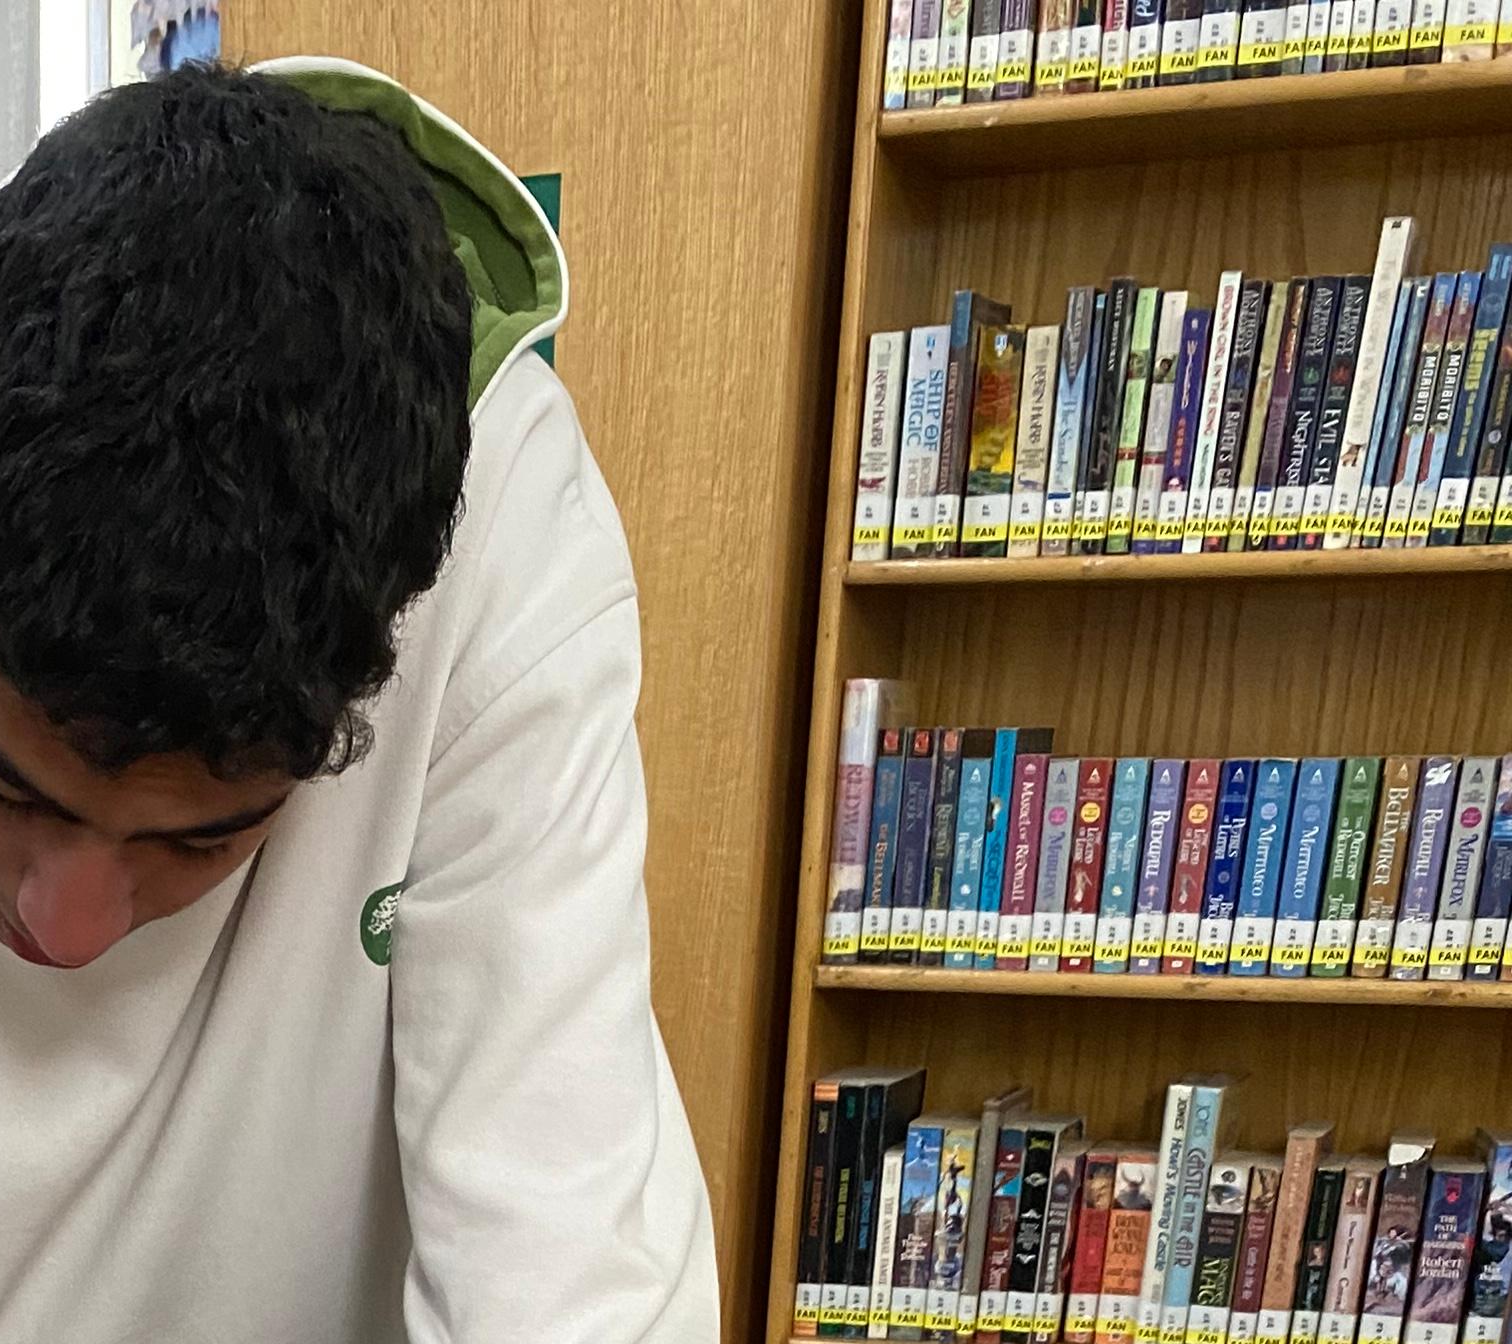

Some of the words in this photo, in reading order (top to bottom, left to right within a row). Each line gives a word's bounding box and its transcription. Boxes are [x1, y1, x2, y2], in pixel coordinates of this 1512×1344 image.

[1415, 32, 1439, 42] FAN
[1460, 30, 1485, 40] FAN
[1376, 35, 1401, 47] FAN
[1205, 50, 1228, 61] FAN
[1253, 47, 1276, 58] FAN
[1132, 61, 1155, 72] FAN
[1171, 56, 1194, 67] FAN
[1003, 66, 1025, 77] FAN
[1040, 68, 1062, 78] FAN
[869, 367, 889, 408] ROBIN
[1028, 363, 1048, 403] ROBIN
[1438, 354, 1462, 420] MORIBITO
[930, 369, 944, 417] SHIP
[1413, 355, 1437, 423] MORIBITO
[906, 378, 926, 446] MAGIC
[1317, 409, 1341, 449] EVIL
[925, 422, 938, 451] OF
[859, 530, 879, 539] FAN
[904, 530, 925, 539] FAN
[975, 528, 996, 537] FAN
[1014, 525, 1035, 535] FAN
[1046, 525, 1069, 535] FAN
[1159, 524, 1182, 535] FAN
[829, 942, 849, 950] FAN
[865, 937, 885, 946] FAN
[894, 936, 914, 946] FAN
[951, 939, 971, 949] FAN
[1002, 943, 1022, 953] FAN
[1036, 942, 1056, 952] FAN
[1070, 943, 1091, 953] FAN
[1101, 947, 1122, 957] FAN
[1136, 944, 1157, 954] FAN
[1170, 943, 1191, 953] FAN
[1202, 949, 1223, 959] FAN
[1241, 948, 1262, 957] FAN
[1281, 950, 1303, 960] FAN
[1322, 950, 1344, 960] FAN
[1402, 952, 1424, 963] FAN
[1438, 951, 1460, 961] FAN
[1476, 950, 1499, 960] FAN
[1173, 1096, 1187, 1130] JONES
[1182, 1146, 1205, 1199] CASTLE
[1421, 1255, 1463, 1266] Robert
[1419, 1266, 1459, 1278] Jordan
[897, 1313, 917, 1322] FAN
[1197, 1333, 1217, 1343] FAN
